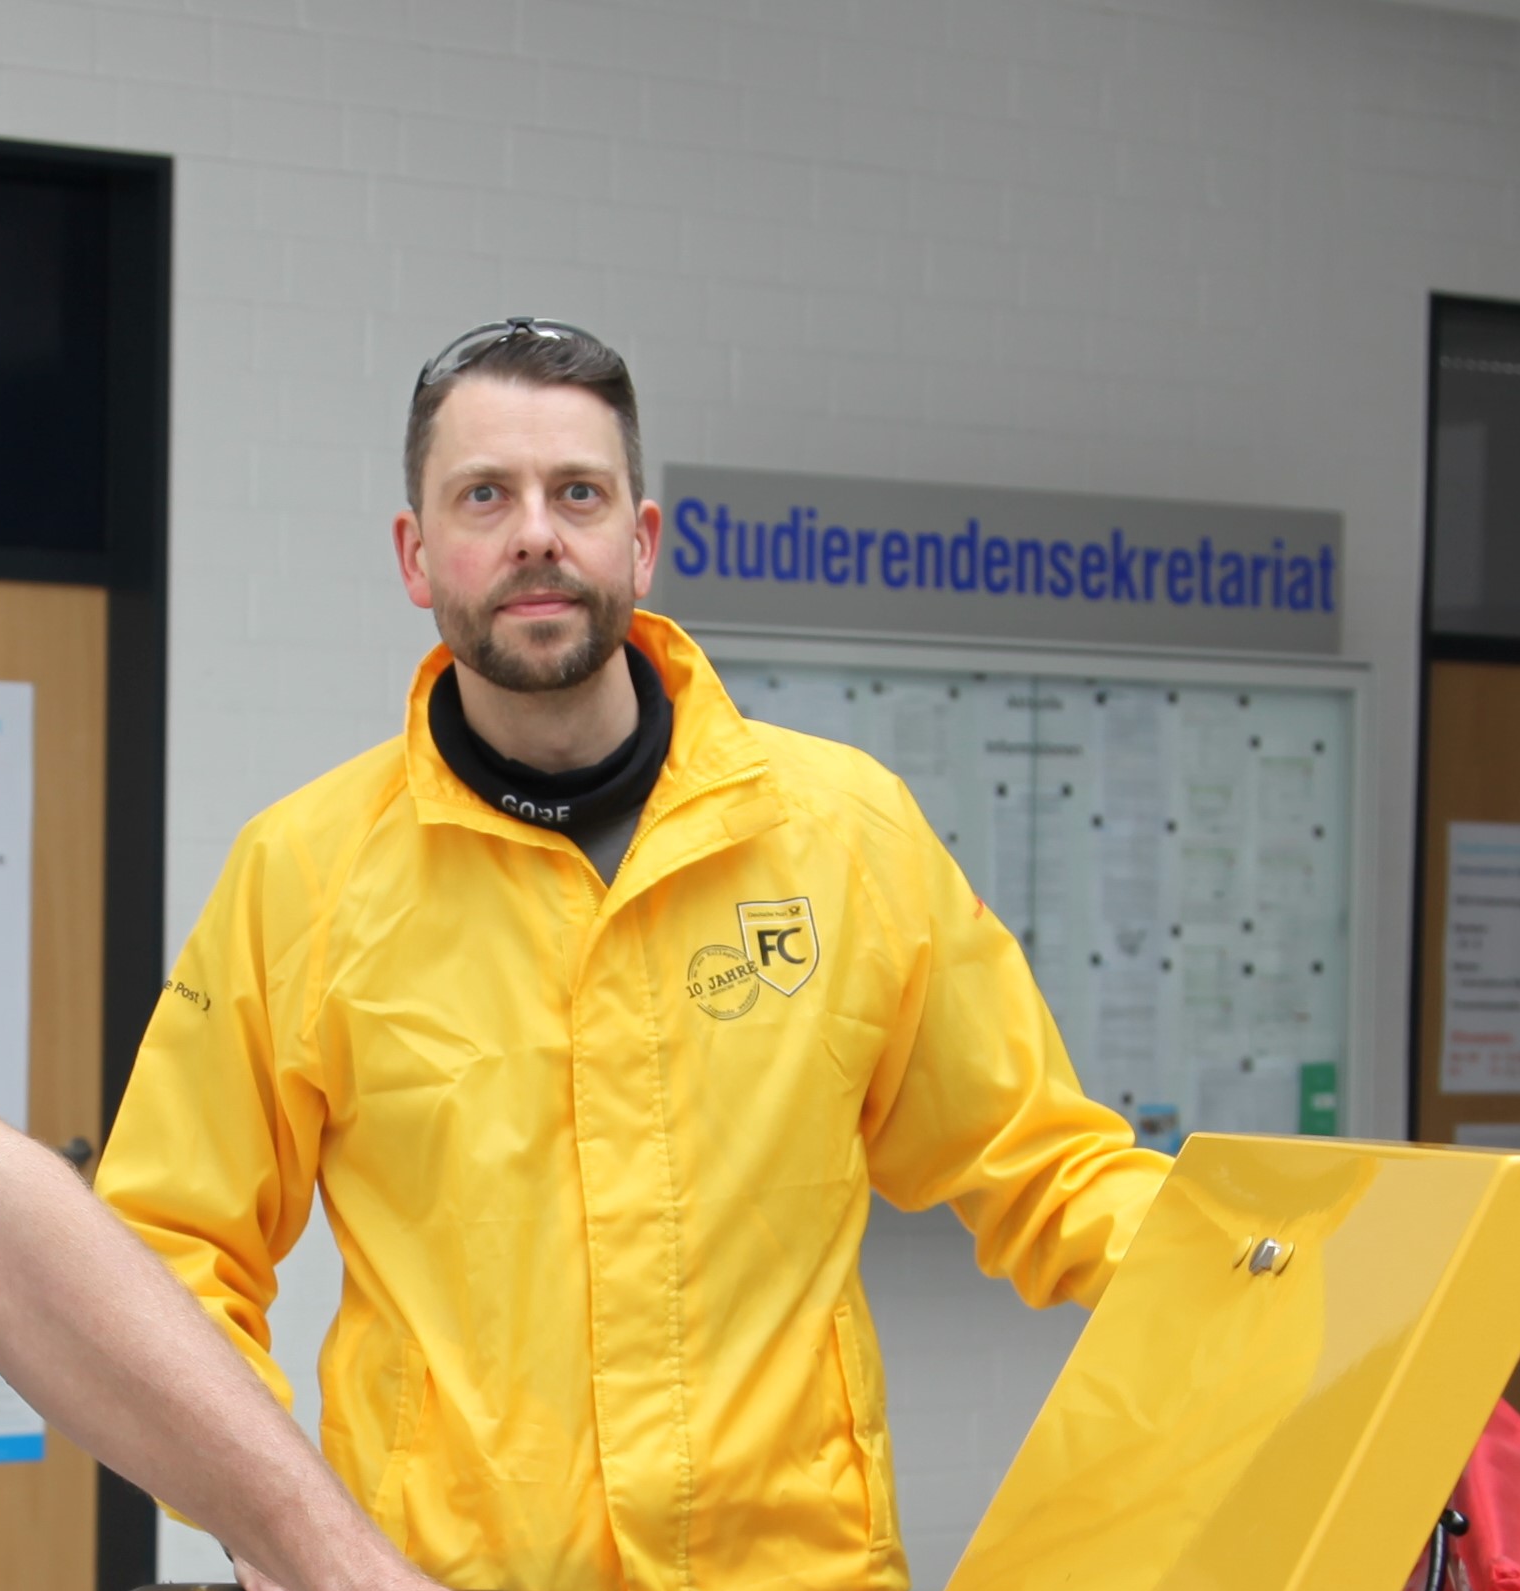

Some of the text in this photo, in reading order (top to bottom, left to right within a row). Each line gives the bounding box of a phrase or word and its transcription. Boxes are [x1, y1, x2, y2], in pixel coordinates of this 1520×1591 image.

[672, 497, 1338, 614] Studierendensekretariat
[757, 926, 807, 967] FC
[173, 981, 200, 1004] Post
[685, 981, 704, 999] 10
[708, 960, 759, 990] JAHRE
